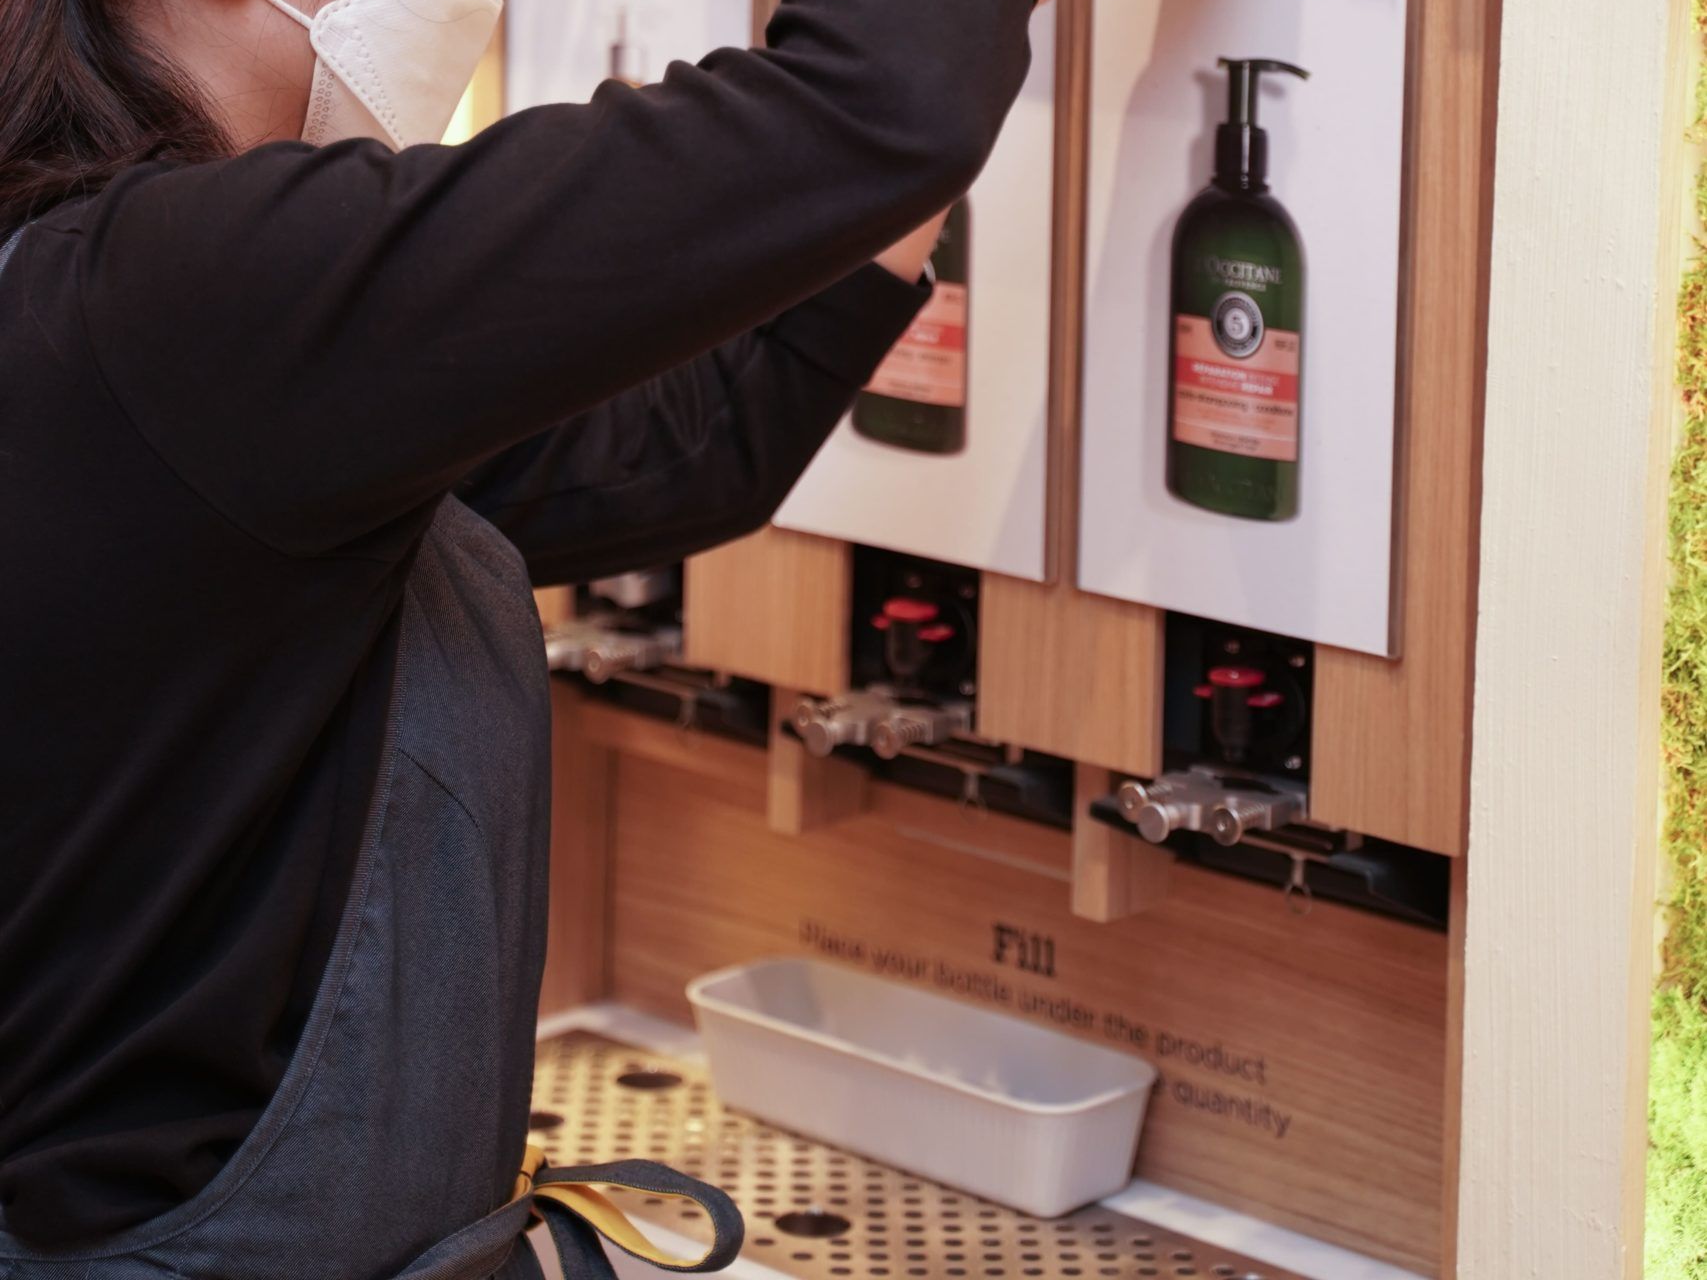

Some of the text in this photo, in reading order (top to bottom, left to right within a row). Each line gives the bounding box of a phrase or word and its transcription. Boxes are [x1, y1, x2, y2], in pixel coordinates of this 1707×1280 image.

[993, 922, 1056, 978] Fill
[870, 946, 927, 982] your
[932, 959, 1010, 1003] bottle
[1018, 991, 1095, 1031] under
[1103, 1011, 1149, 1048] the
[1156, 1030, 1267, 1087] product
[1172, 1078, 1293, 1140] quantity
